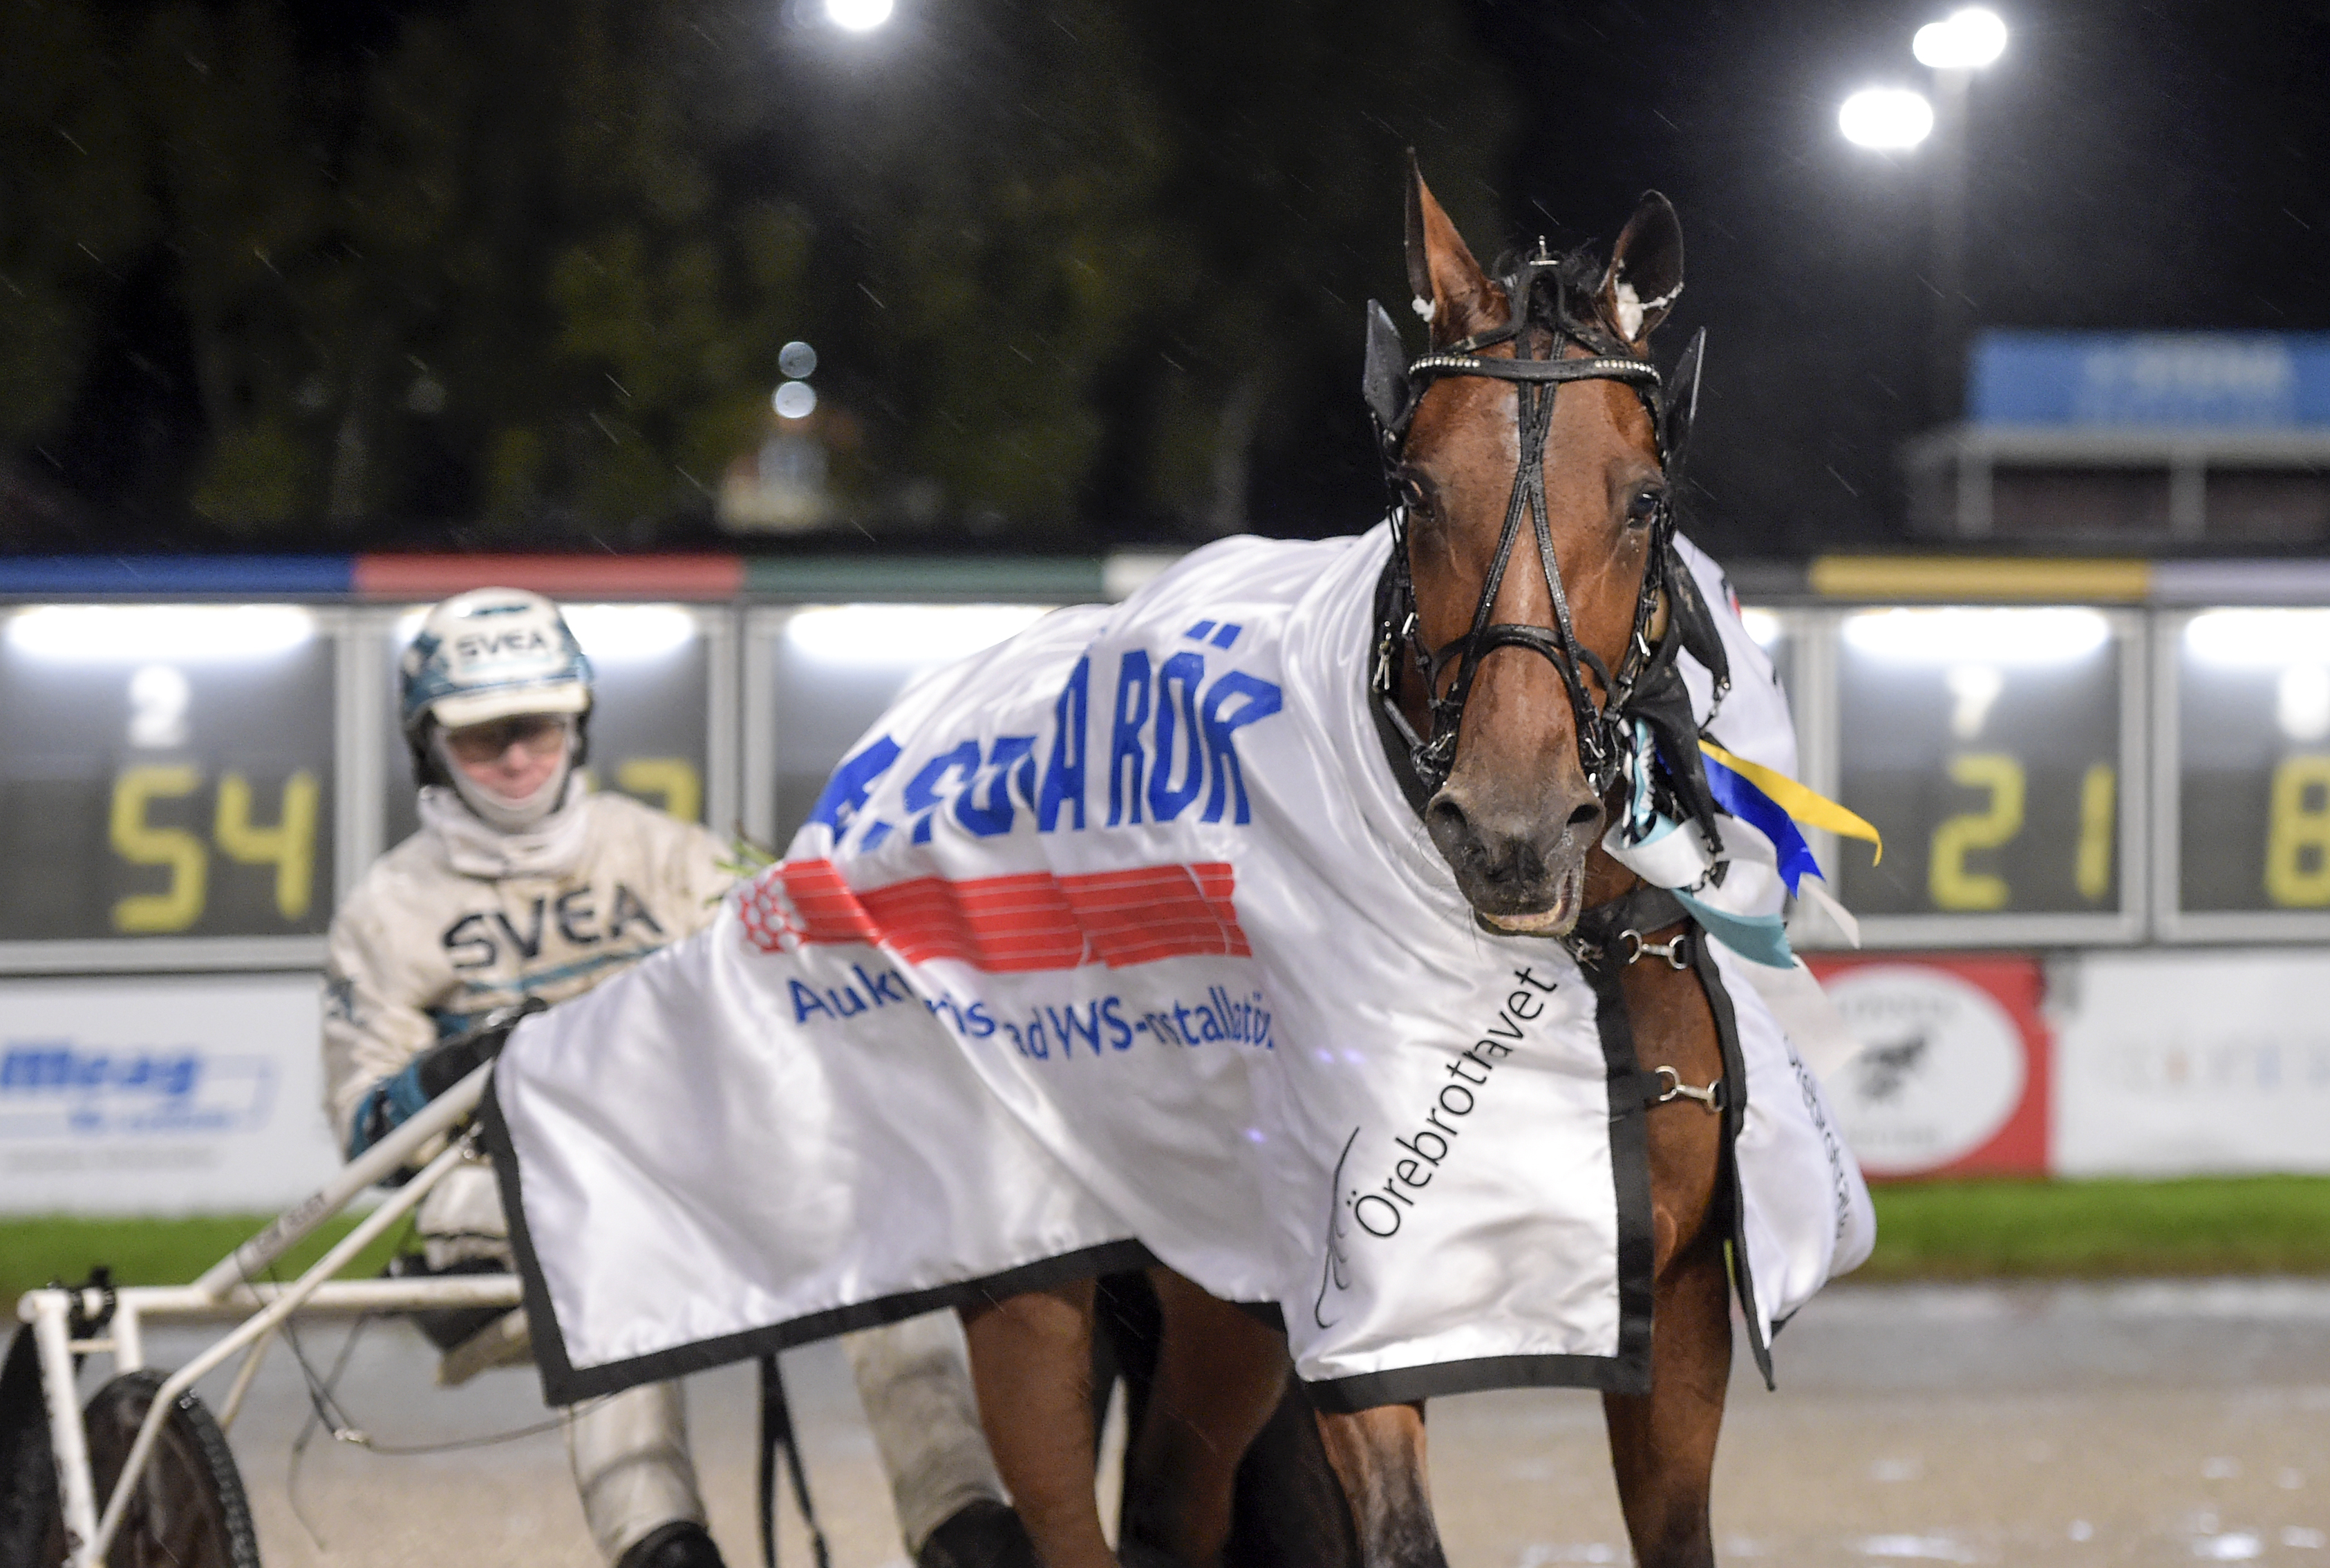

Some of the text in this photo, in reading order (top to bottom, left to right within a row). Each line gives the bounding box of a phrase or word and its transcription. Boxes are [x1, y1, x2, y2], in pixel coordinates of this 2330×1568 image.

[456, 630, 546, 657] SVEA
[1105, 620, 1282, 826] RÖR
[111, 764, 319, 933] 54
[1928, 753, 2116, 911] 21
[442, 885, 664, 969] SVEA
[1346, 967, 1558, 1238] Örebrotravet
